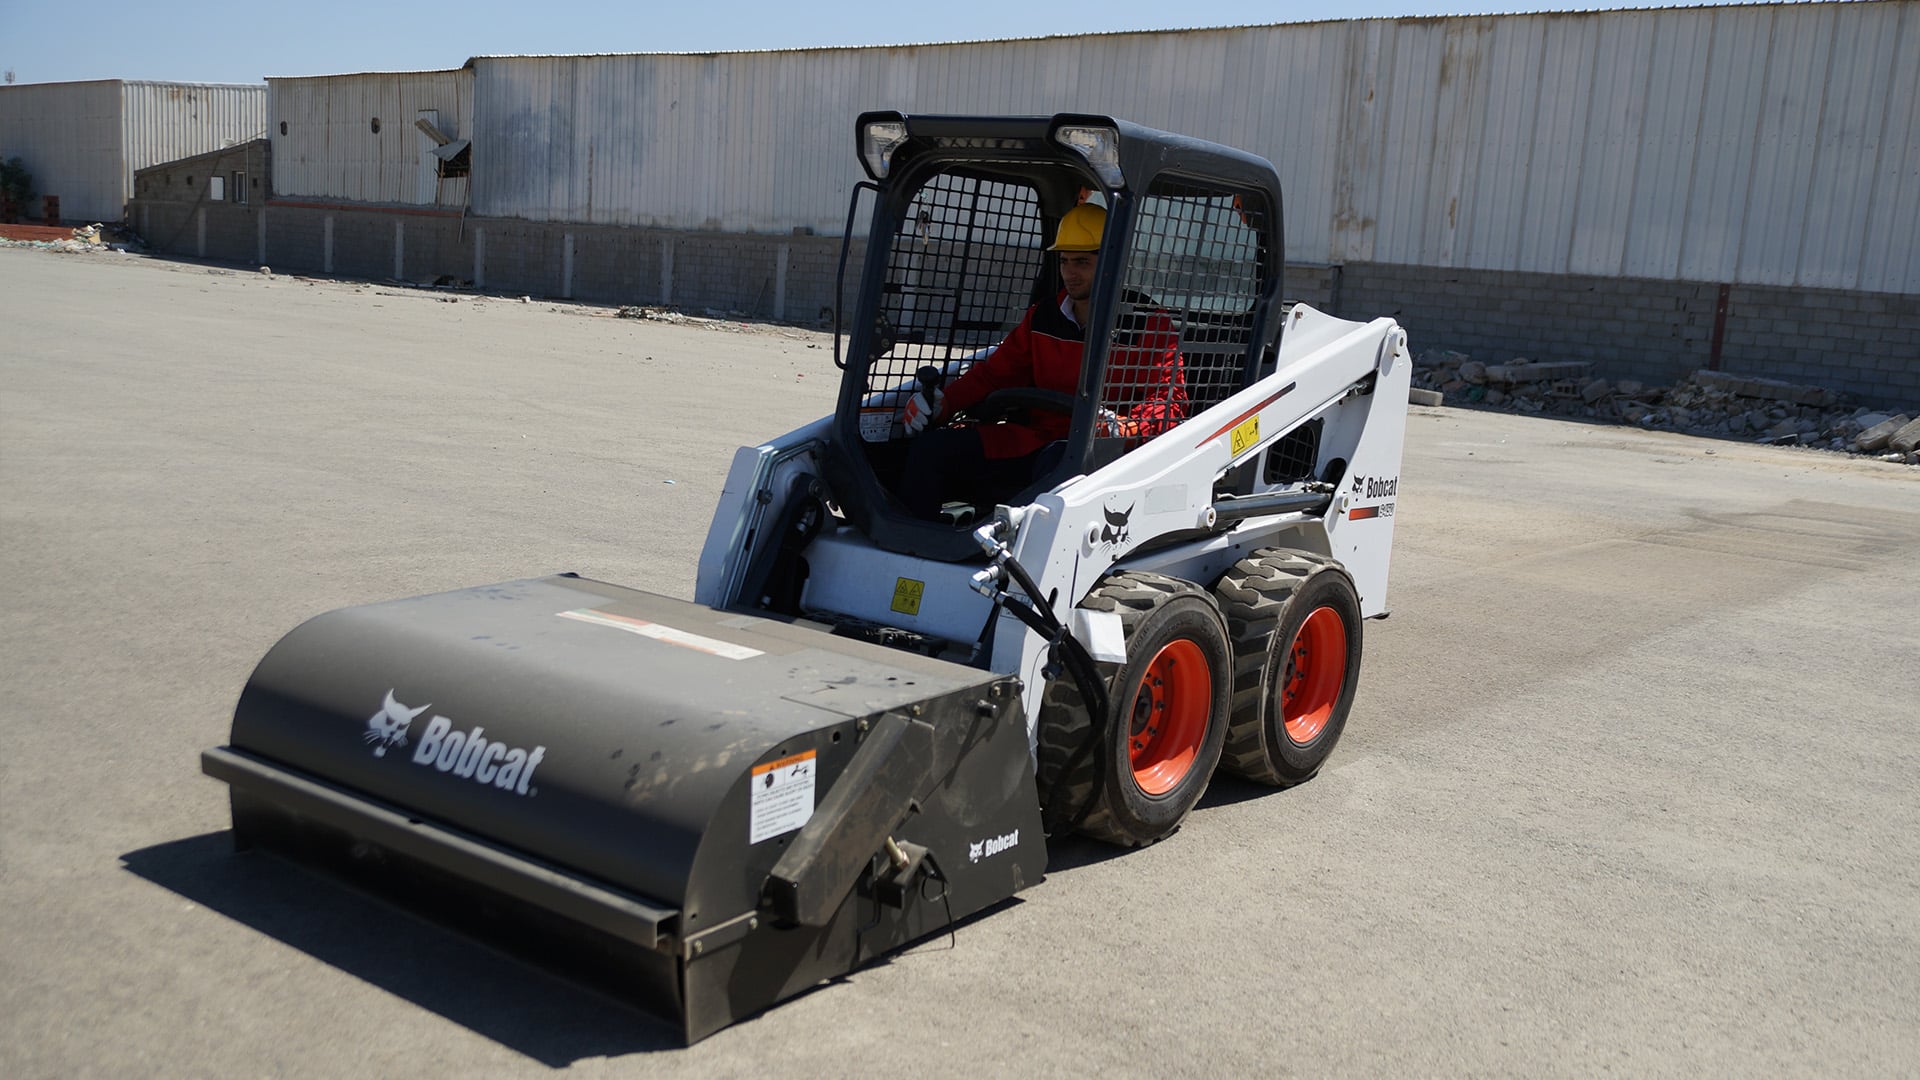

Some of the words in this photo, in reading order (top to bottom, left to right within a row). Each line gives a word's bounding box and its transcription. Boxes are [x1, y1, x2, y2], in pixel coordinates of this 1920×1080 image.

[1366, 476, 1398, 499] Bobcat
[412, 714, 547, 796] Bobcat
[985, 828, 1019, 858] Bobcat
